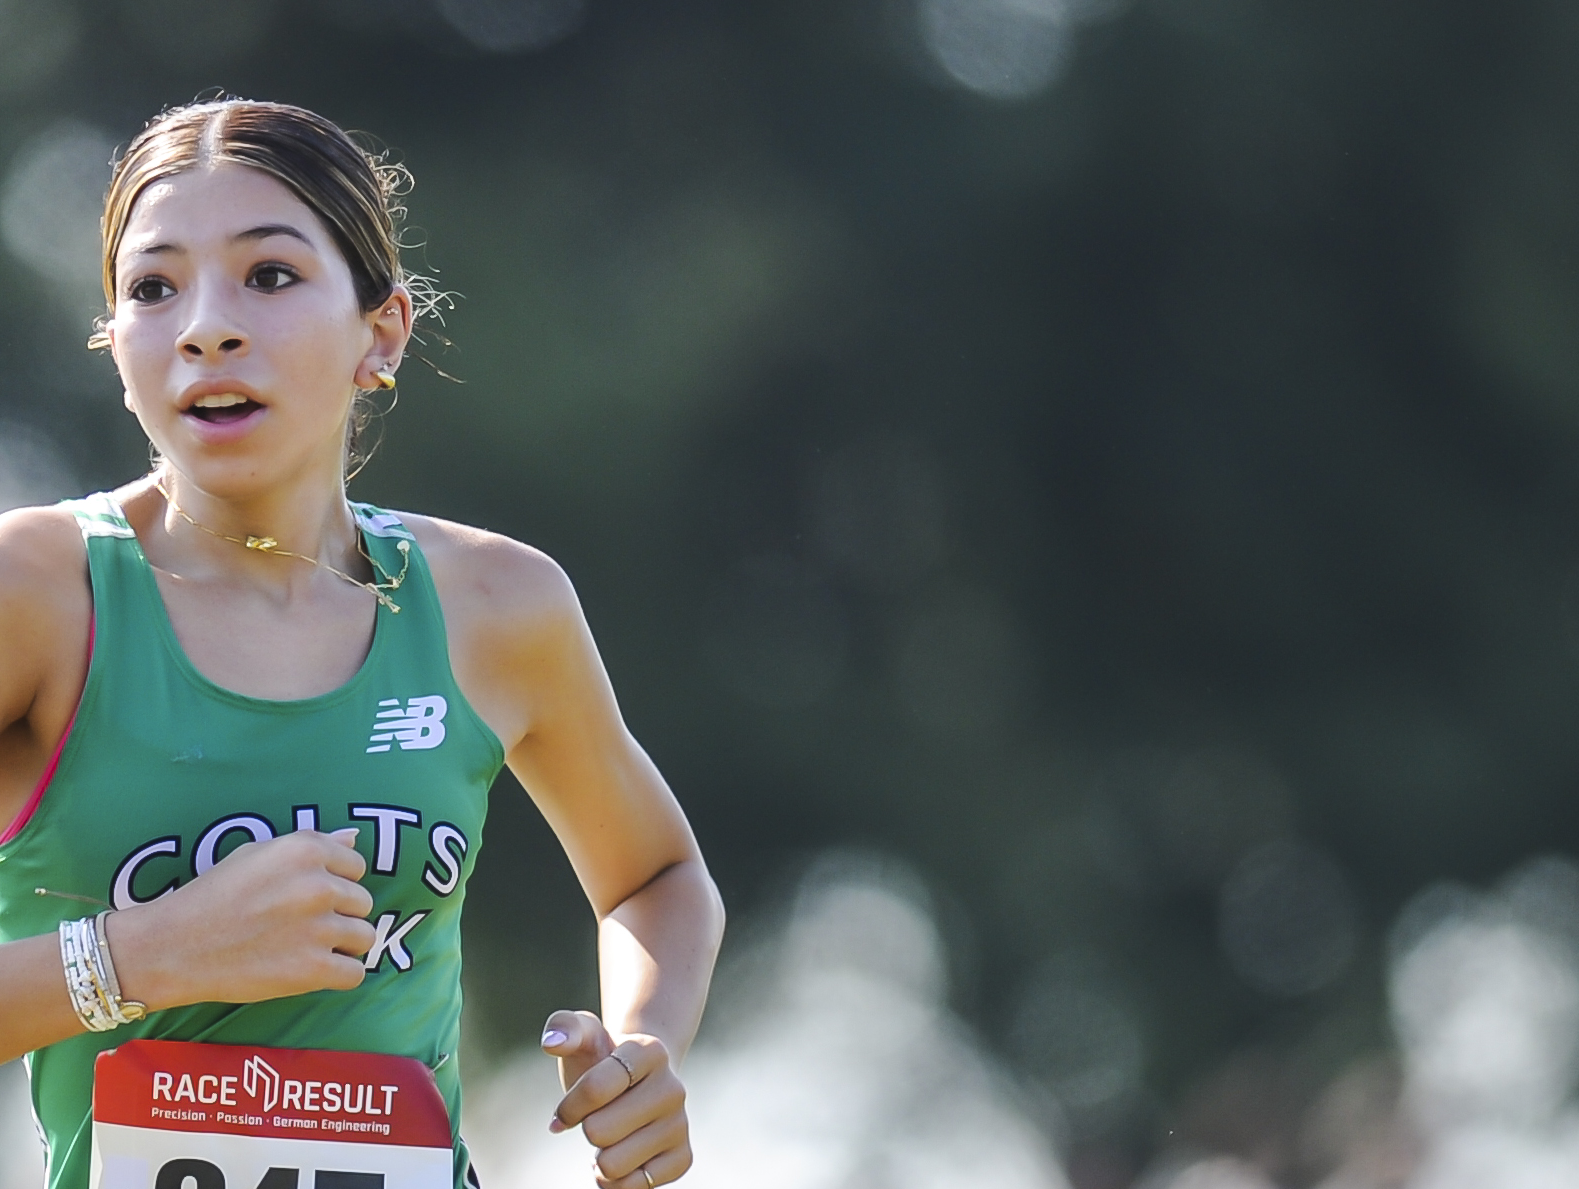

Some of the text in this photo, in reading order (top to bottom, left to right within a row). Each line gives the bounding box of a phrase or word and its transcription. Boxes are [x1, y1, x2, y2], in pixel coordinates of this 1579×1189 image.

[365, 695, 448, 753] NB
[152, 1071, 399, 1116] RACE RESULT
[151, 1107, 391, 1136] Precision Passion German Engineering
